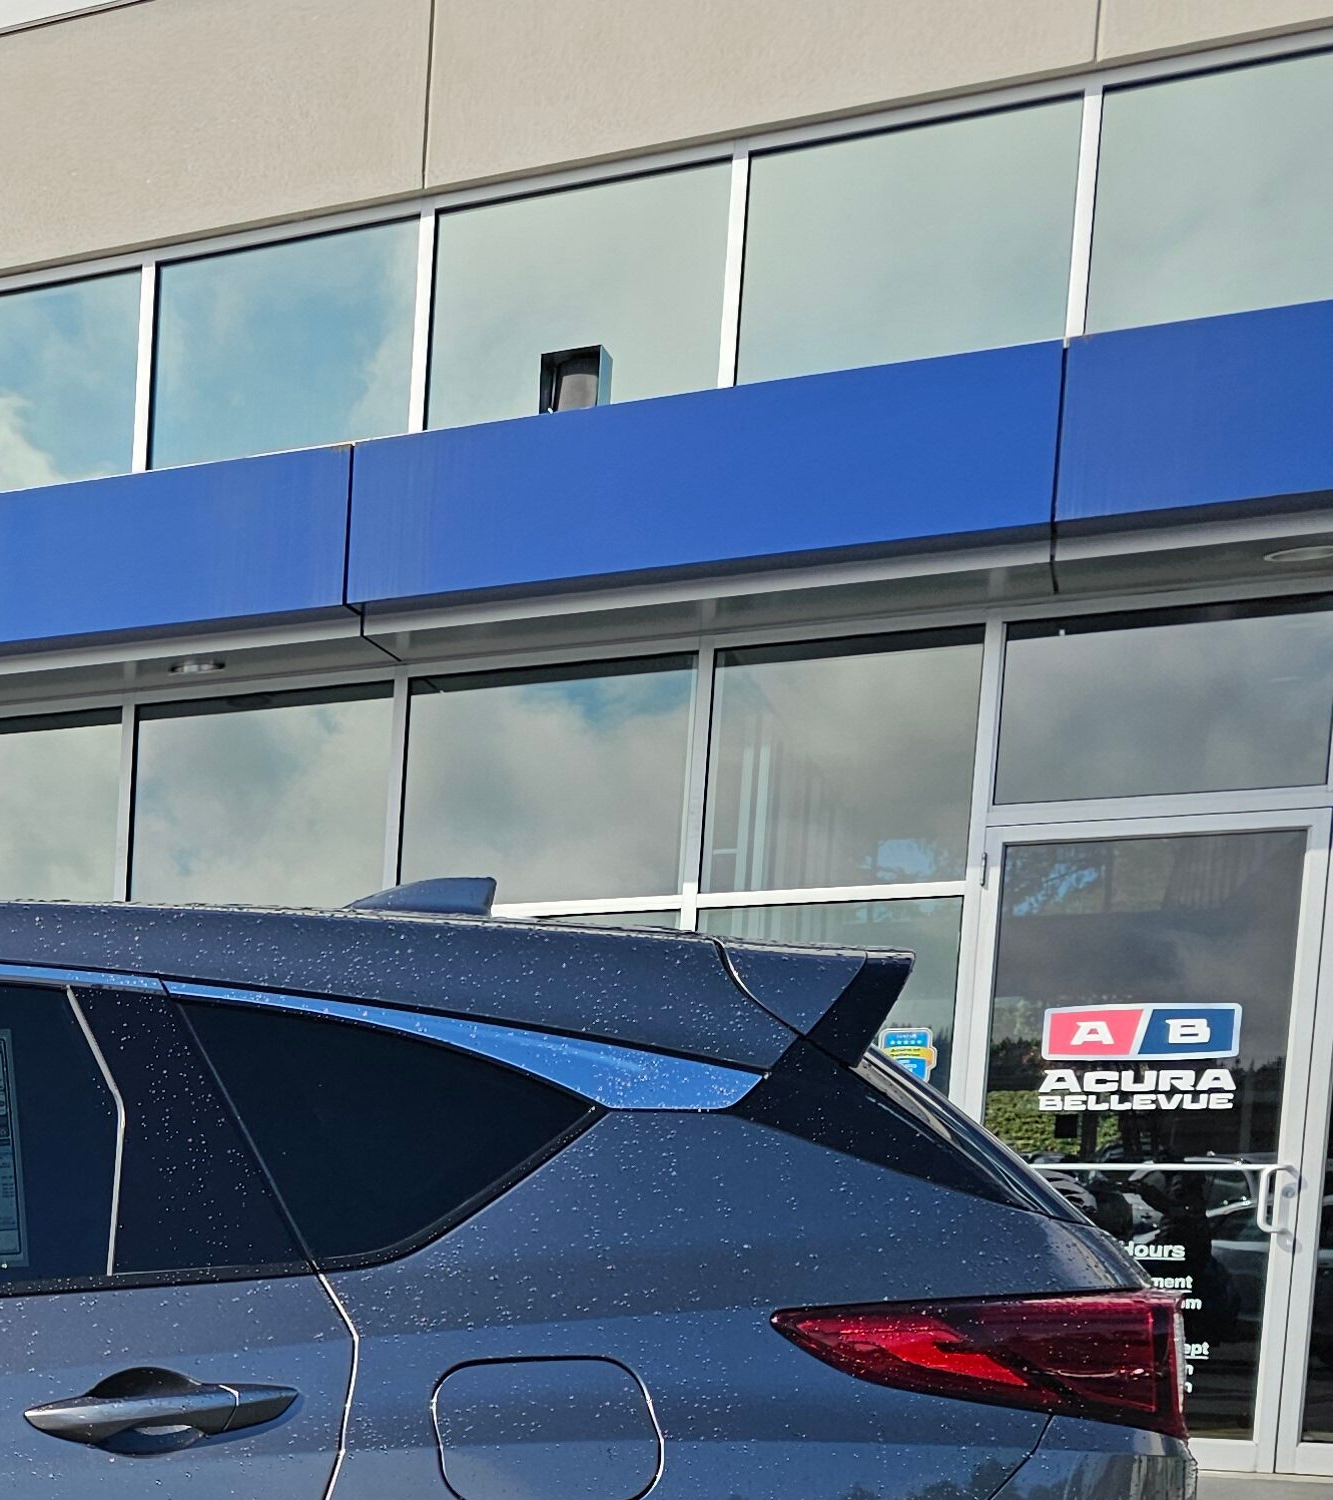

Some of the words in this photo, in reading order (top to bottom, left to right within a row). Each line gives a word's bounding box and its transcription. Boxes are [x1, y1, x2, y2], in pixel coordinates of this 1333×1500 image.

[1069, 1021, 1115, 1046] A
[1165, 1018, 1211, 1044] B
[1037, 1068, 1237, 1093] ACURA
[1037, 1092, 1234, 1111] BELLEVUE
